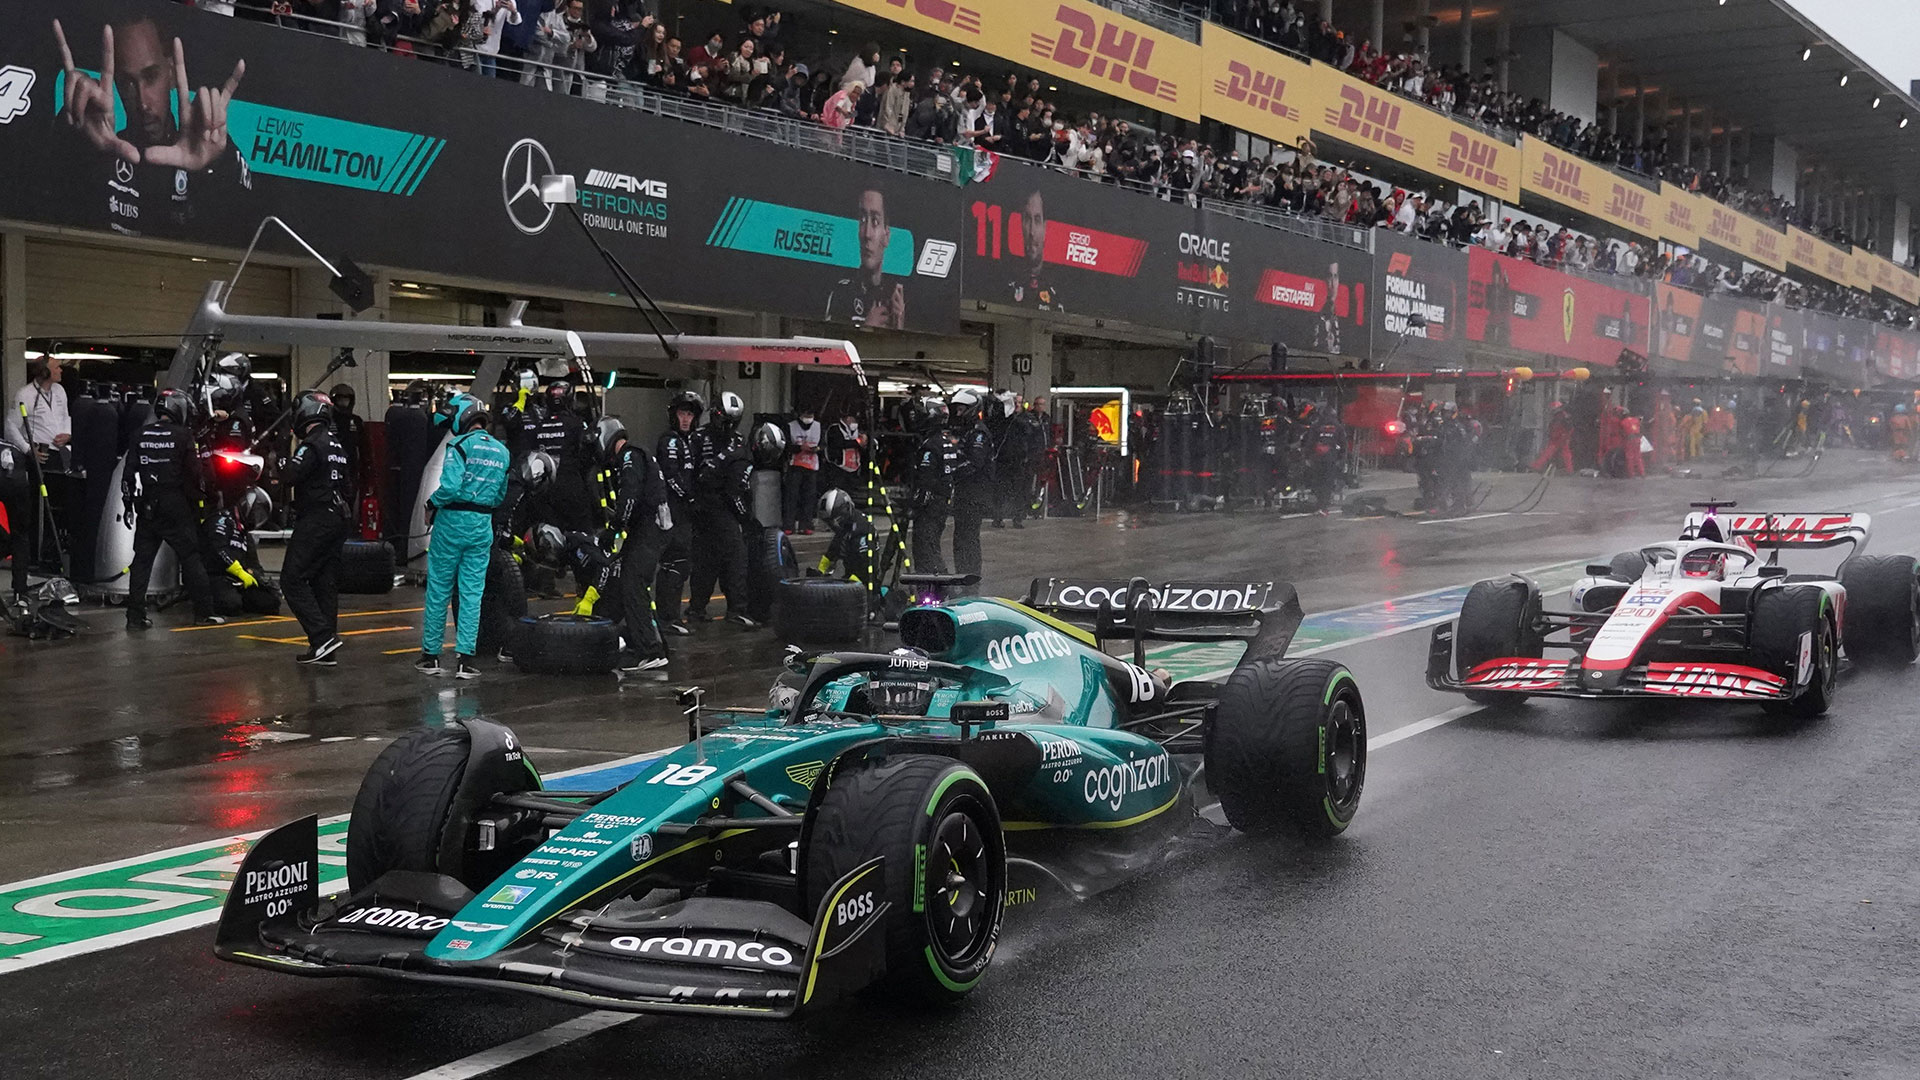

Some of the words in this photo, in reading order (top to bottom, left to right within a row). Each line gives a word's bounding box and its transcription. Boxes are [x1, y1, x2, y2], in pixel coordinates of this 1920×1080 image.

[1053, 4, 1159, 95] DHL
[1226, 60, 1288, 118] DHL
[256, 116, 304, 138] LEWIS
[1337, 84, 1404, 151] DHL
[251, 135, 384, 181] HAMILTON
[1447, 131, 1499, 187] DHL
[611, 173, 667, 198] AMG
[1541, 152, 1583, 202] DHL
[120, 202, 138, 218] UBS
[1611, 183, 1646, 227] DHL
[584, 213, 624, 231] FORMULA
[627, 220, 643, 235] ONE
[646, 223, 667, 238] TEAM
[801, 218, 834, 236] GEORGE
[971, 201, 1001, 259] 11
[774, 229, 833, 257] RUSSELL
[1069, 232, 1090, 246] SERGIO
[1179, 232, 1231, 262] ORACLE
[917, 239, 957, 278] 63
[1066, 244, 1098, 265] PEREZ
[1272, 285, 1315, 307] VERSTAPPEN
[1385, 274, 1420, 299] FORMULA
[1421, 283, 1426, 301] 1
[1177, 291, 1229, 312] RACING
[1355, 282, 1365, 326] 1
[1385, 294, 1410, 315] HONDA
[1411, 301, 1445, 323] JAPANESE
[1384, 313, 1408, 335] GRAN
[1014, 356, 1031, 372] 10
[1614, 607, 1657, 618] 20
[988, 631, 1071, 670] aramco
[1120, 661, 1154, 703] 18
[986, 709, 1004, 717] BOSS
[505, 751, 521, 761] TikTok
[1041, 739, 1081, 761] PERONI
[1062, 757, 1082, 767] AZZURRO
[646, 763, 718, 786] 18
[1084, 747, 1170, 812] cognizant
[585, 813, 645, 823] PERONI
[537, 845, 598, 858] NetApp
[554, 836, 613, 845] SentinelOne
[631, 835, 652, 860] FIA
[245, 861, 308, 894] PERONI
[534, 871, 559, 880] IFS
[245, 892, 273, 904] NASTRO
[275, 884, 308, 899] AZZURRO
[1004, 887, 1036, 907] ARTIN
[267, 898, 292, 918] 0.0%
[338, 905, 450, 931] aramco
[838, 891, 874, 926] BOSS
[610, 935, 793, 966] aramco
